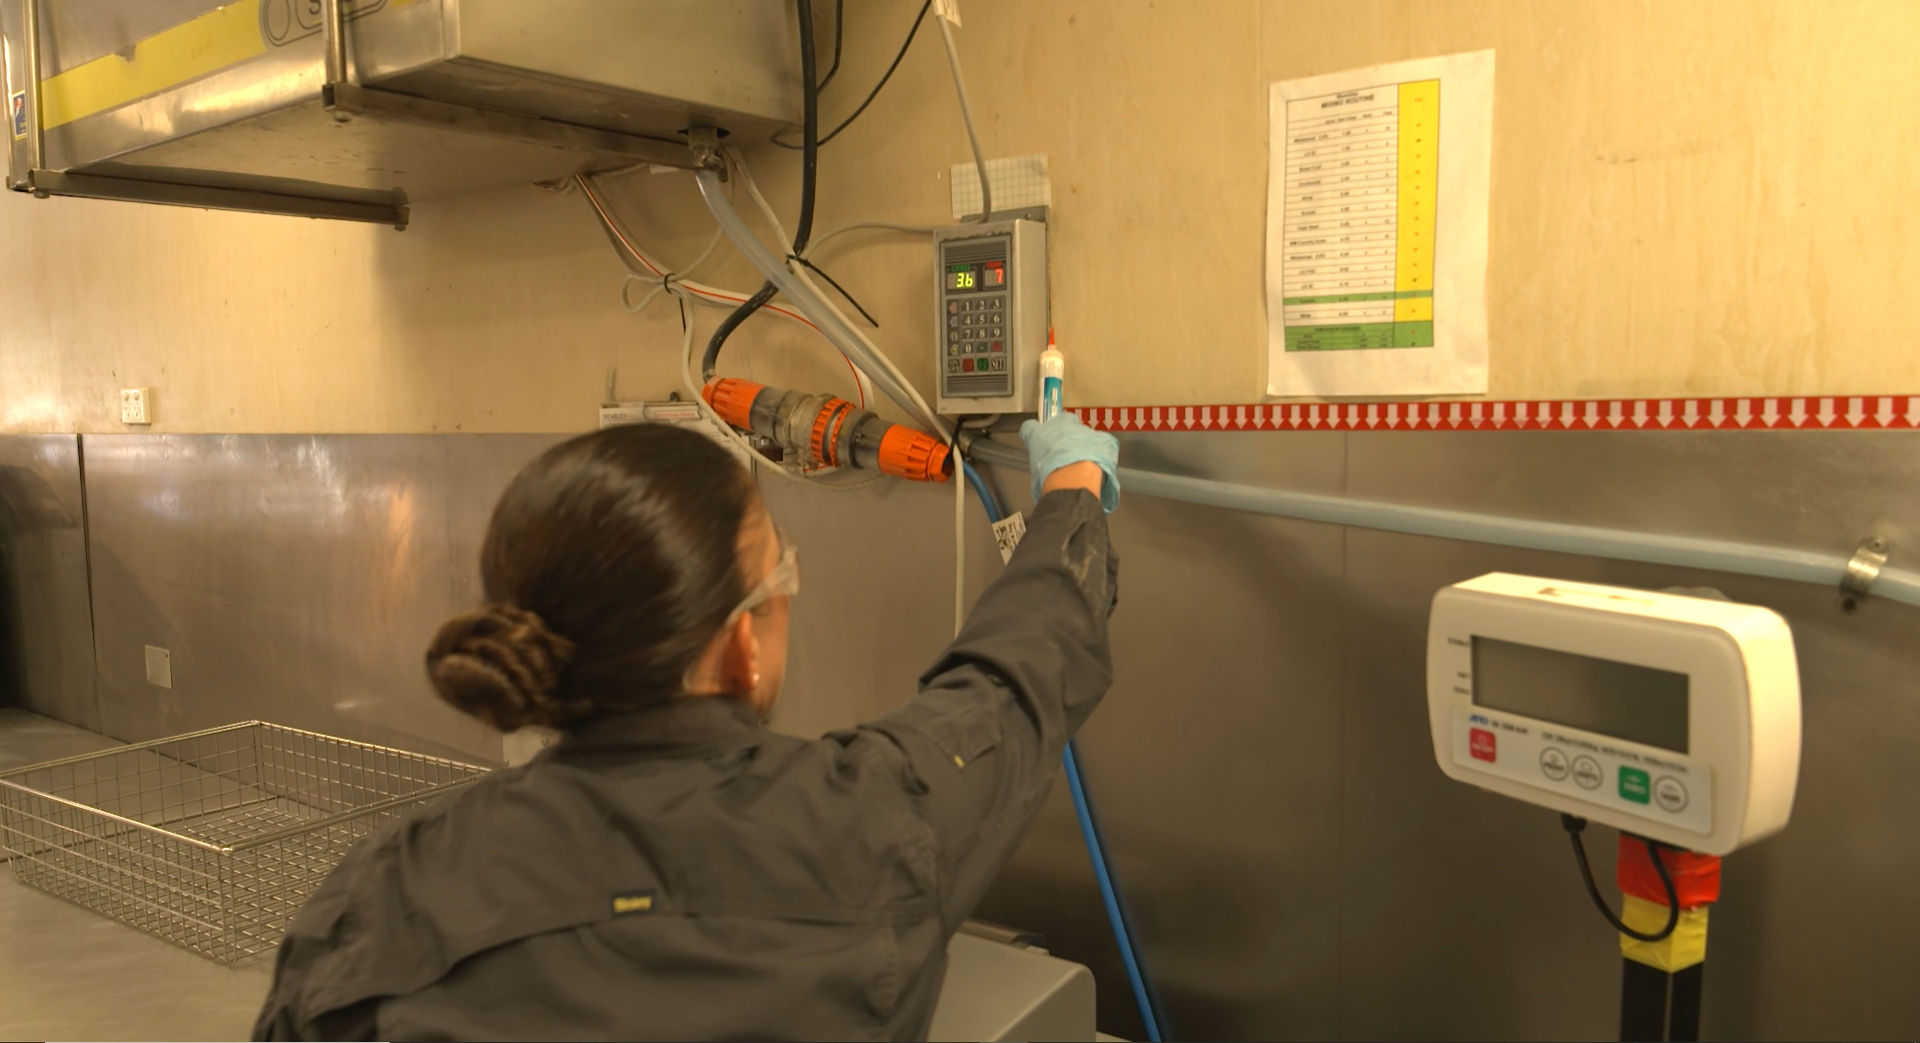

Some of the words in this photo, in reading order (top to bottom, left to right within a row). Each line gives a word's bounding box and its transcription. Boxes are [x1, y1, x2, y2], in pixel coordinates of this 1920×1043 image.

[994, 268, 1004, 284] 7
[993, 299, 1000, 309] 3
[964, 315, 971, 325] 4
[993, 313, 1000, 324] 6
[965, 329, 971, 340] 7
[979, 329, 986, 339] 8
[993, 327, 1000, 338] 9
[965, 343, 972, 354] 0
